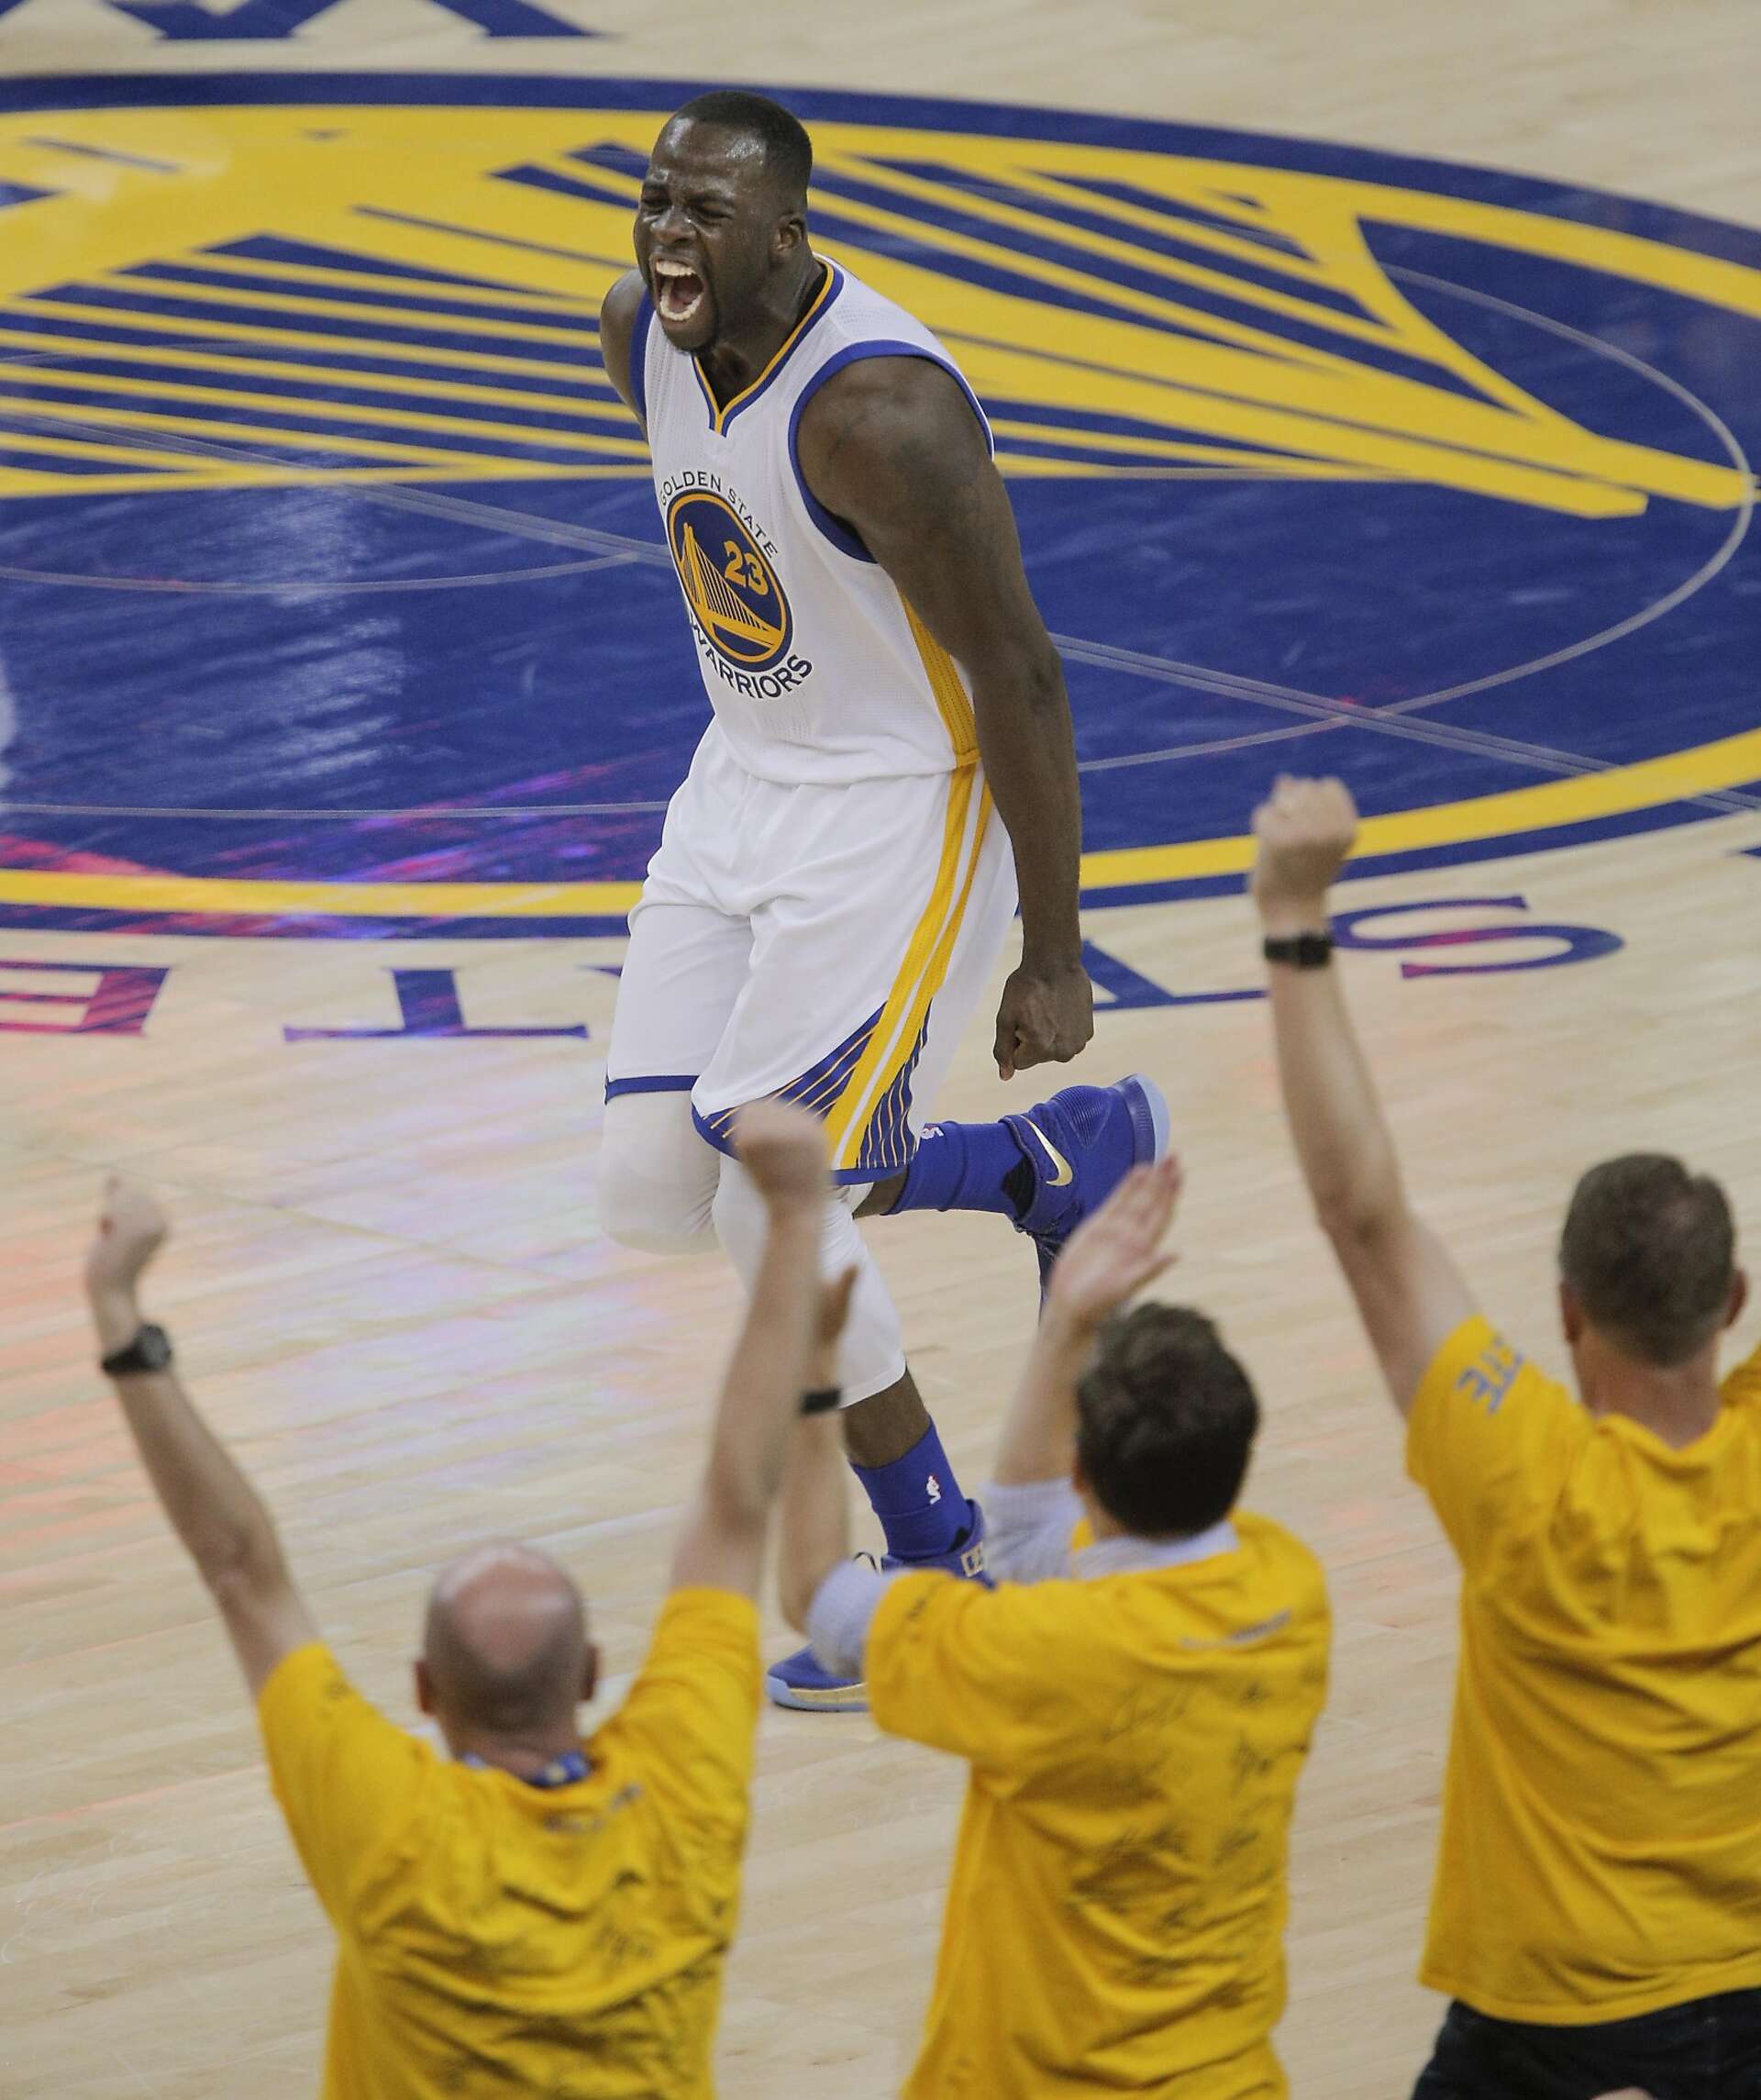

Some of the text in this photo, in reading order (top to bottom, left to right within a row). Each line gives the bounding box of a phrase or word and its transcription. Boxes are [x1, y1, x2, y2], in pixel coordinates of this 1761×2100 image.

[659, 471, 779, 559] GOLDEN STATE
[724, 539, 770, 596] 23
[689, 607, 813, 699] WARRIORS
